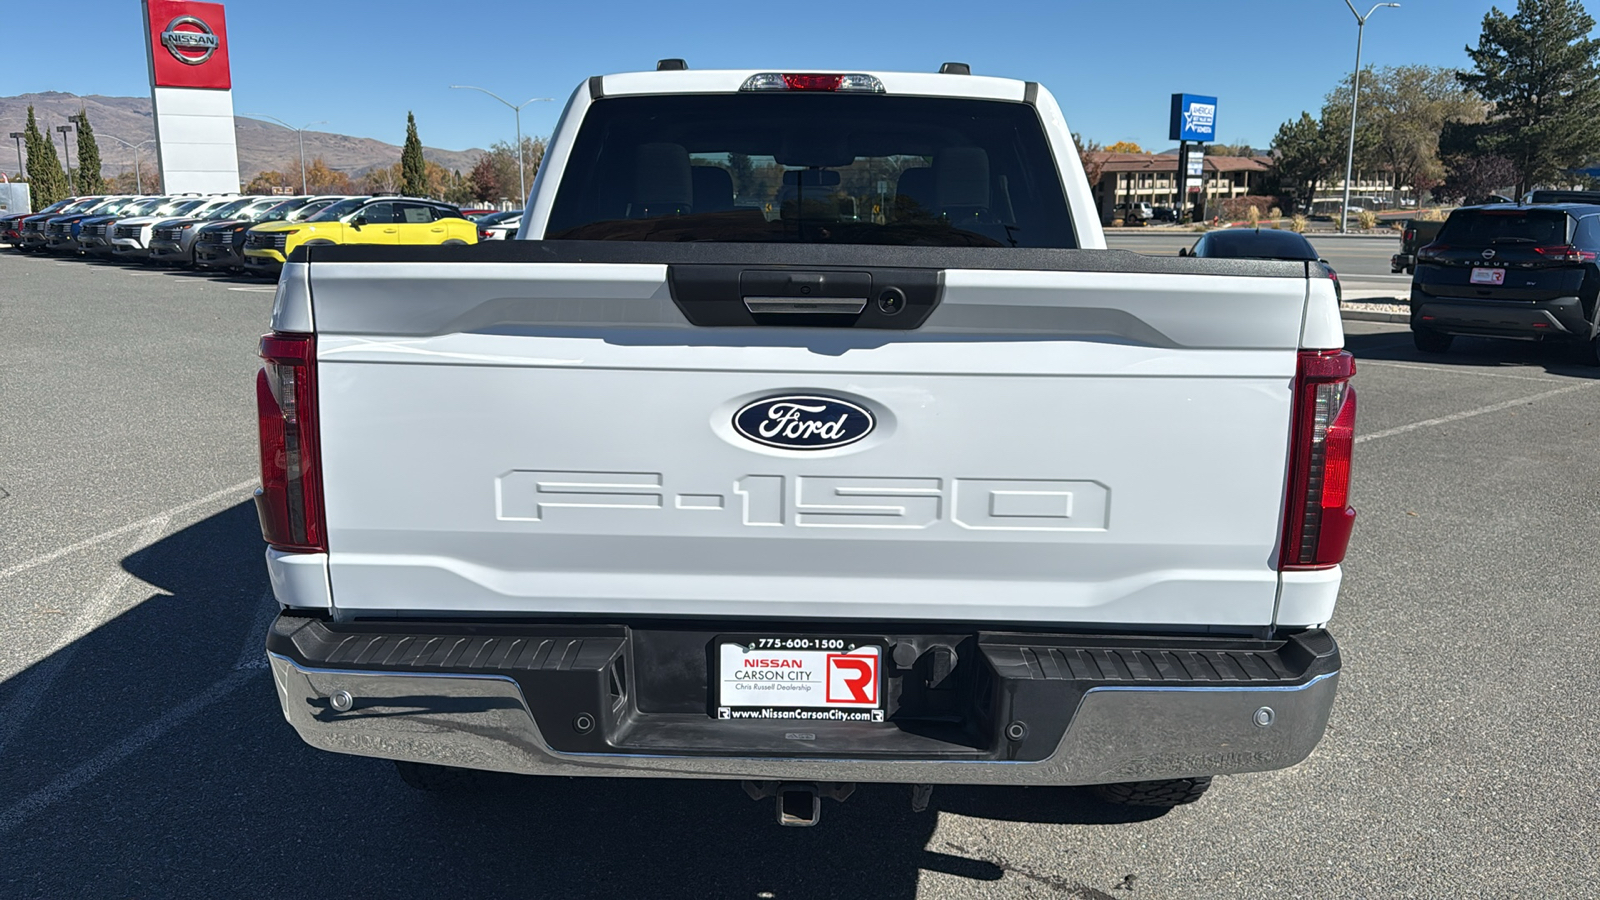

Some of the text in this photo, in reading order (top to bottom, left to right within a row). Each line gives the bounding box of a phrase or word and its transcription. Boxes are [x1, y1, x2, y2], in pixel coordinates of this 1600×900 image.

[168, 34, 215, 45] NISSAN
[759, 402, 849, 440] Ford
[495, 469, 1112, 533] F-150
[758, 638, 844, 649] 775-600-1500
[744, 659, 803, 668] NISSAN
[734, 670, 812, 681] CARSON CITY
[831, 659, 873, 702] R
[735, 683, 812, 692] Chris Russell Dealership
[732, 708, 871, 722] www.NissanCarsonCity.com
